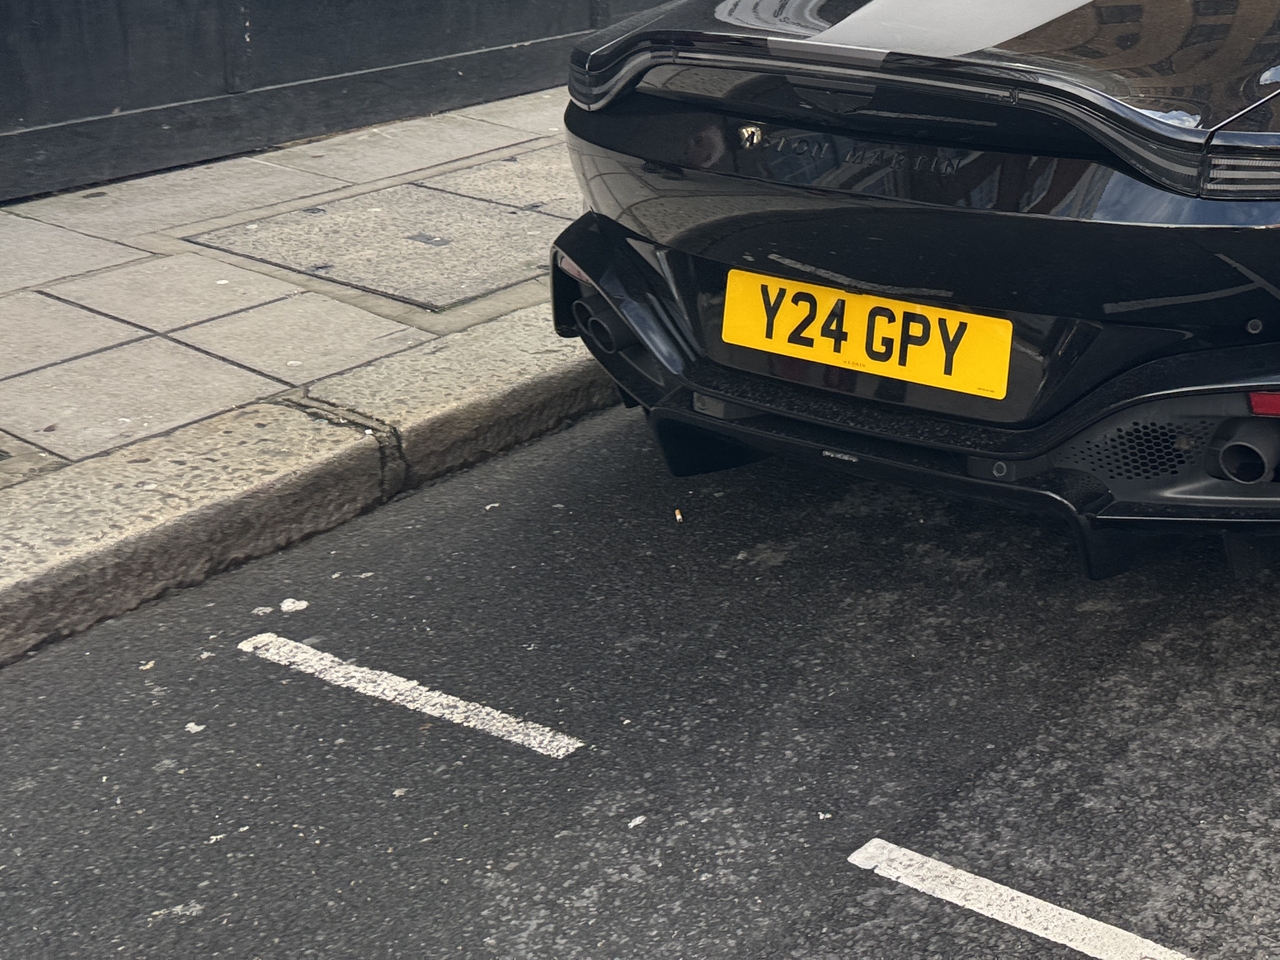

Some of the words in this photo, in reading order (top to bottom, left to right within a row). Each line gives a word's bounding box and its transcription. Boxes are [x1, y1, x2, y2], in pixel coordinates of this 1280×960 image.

[846, 146, 963, 176] MARTIN
[761, 283, 848, 353] Y24
[864, 306, 969, 376] GPY
